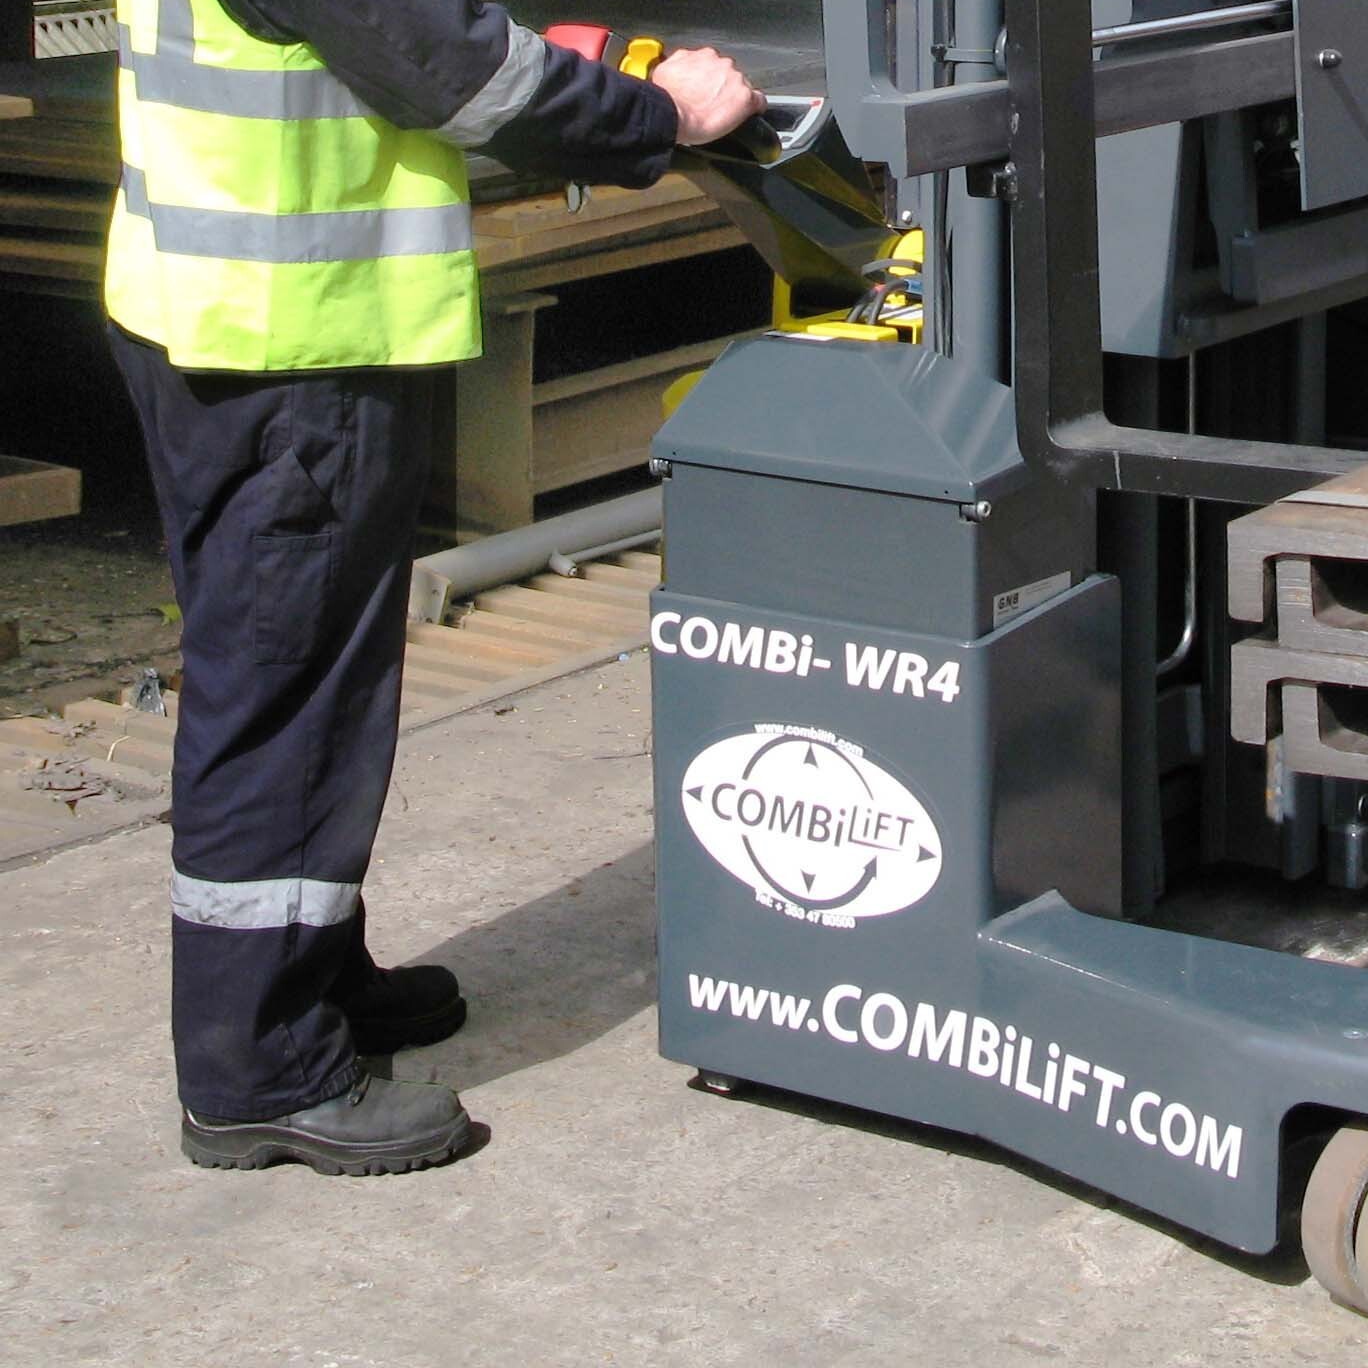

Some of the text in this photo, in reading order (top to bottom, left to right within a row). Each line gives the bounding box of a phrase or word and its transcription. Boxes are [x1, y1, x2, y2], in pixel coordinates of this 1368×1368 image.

[845, 642, 961, 703] WR4
[754, 723, 864, 758] www.combilift.com
[807, 910, 820, 924] 47
